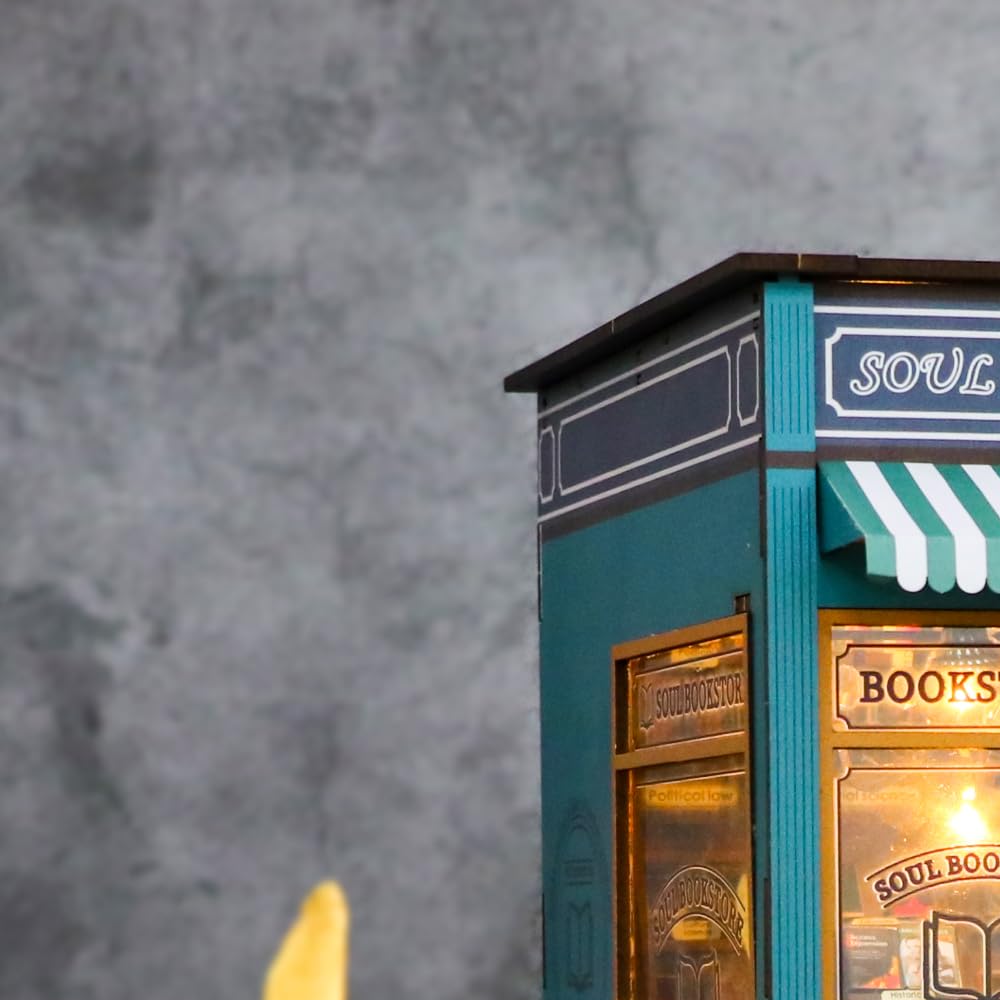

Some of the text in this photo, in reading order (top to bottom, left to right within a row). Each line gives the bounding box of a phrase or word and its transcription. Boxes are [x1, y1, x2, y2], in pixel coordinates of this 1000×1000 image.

[850, 348, 995, 396] SOUL
[656, 673, 743, 719] SOUL BOOKSTOR
[874, 859, 941, 902] SOUL
